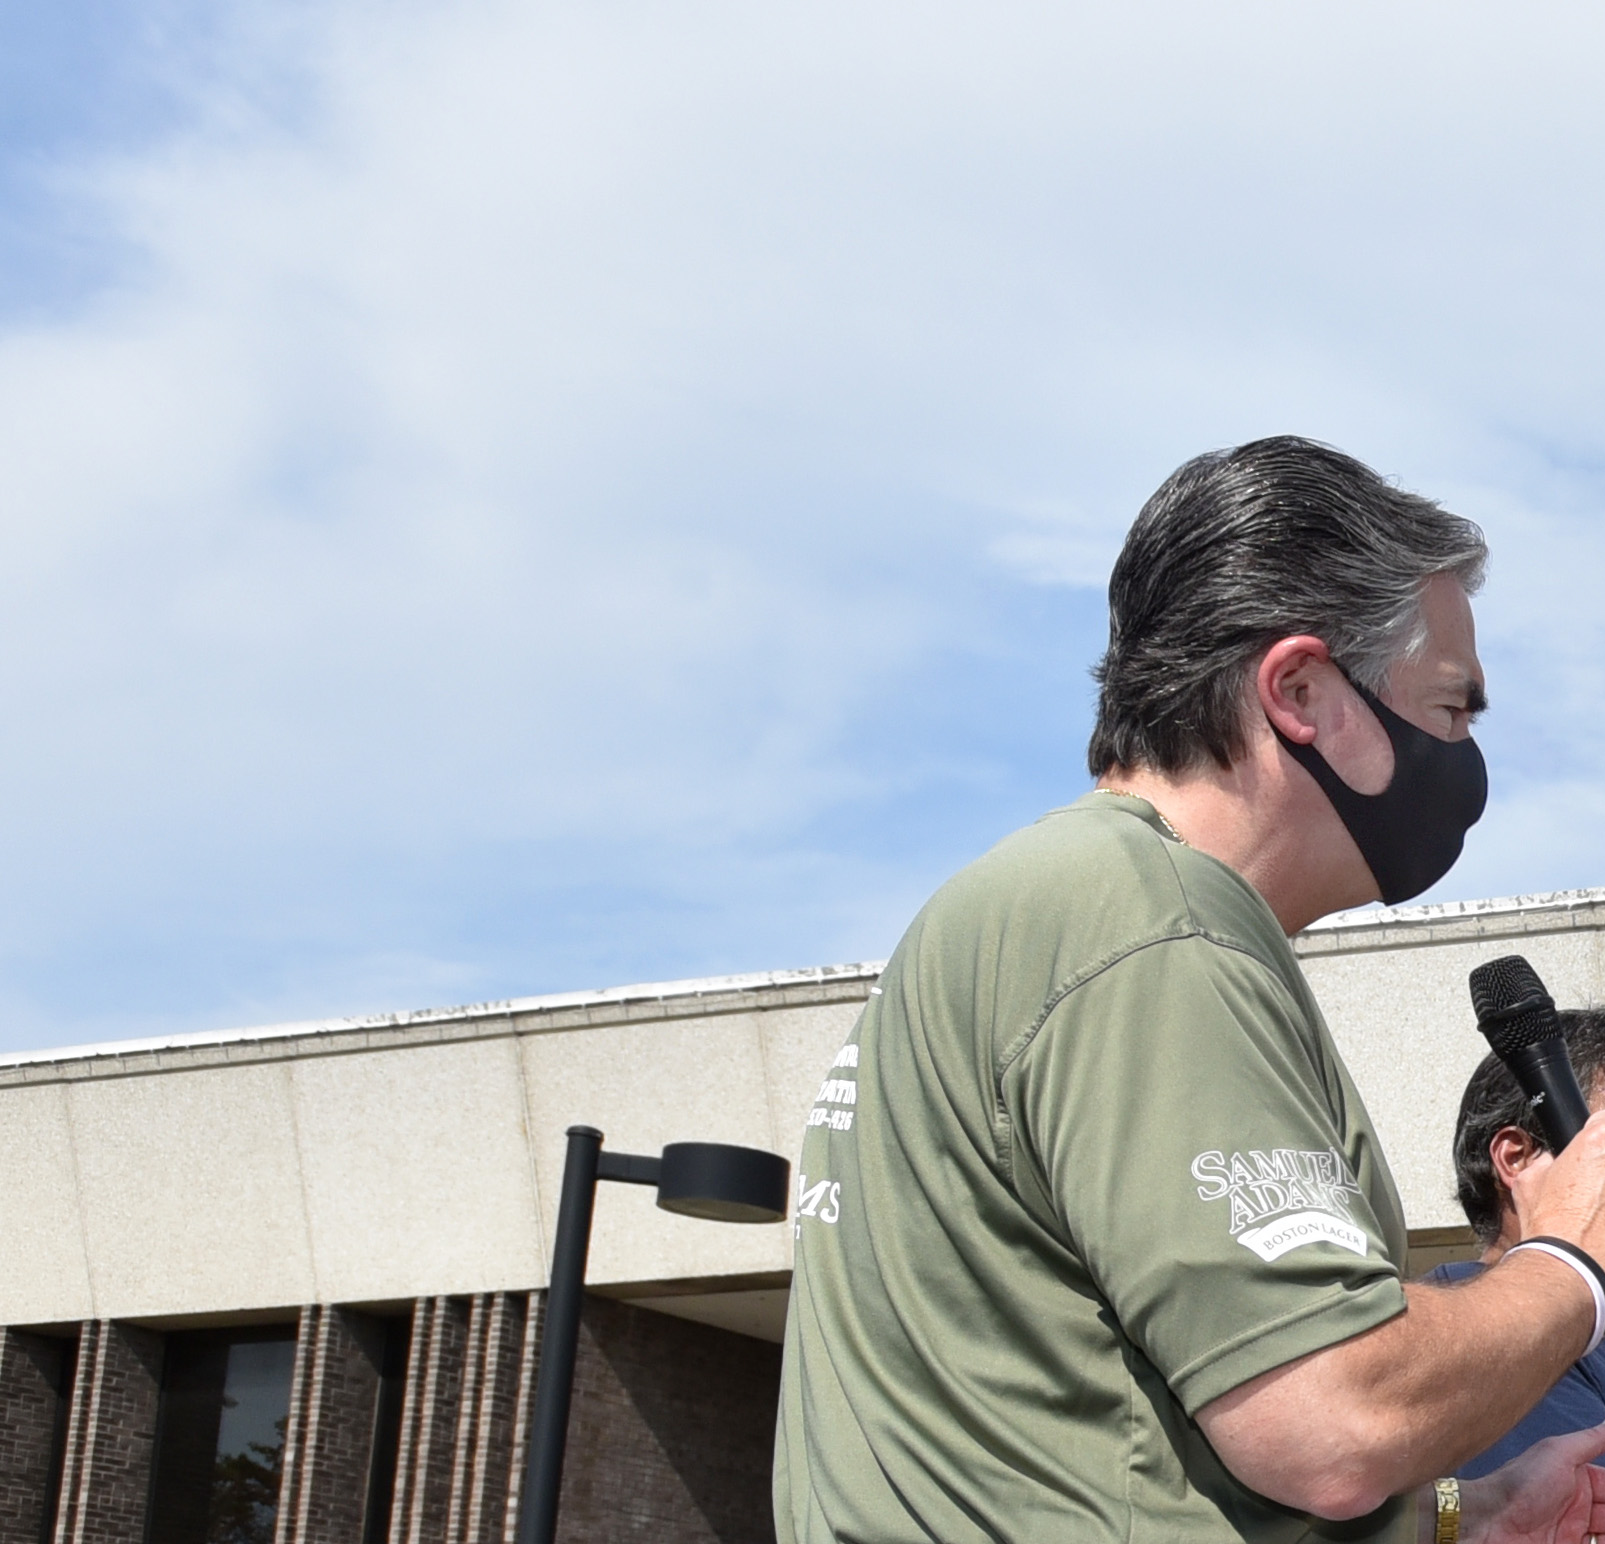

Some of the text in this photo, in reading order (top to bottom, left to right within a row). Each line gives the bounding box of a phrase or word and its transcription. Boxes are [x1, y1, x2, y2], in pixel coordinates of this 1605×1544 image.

[1191, 1147, 1363, 1201] SAMUEL
[1229, 1177, 1358, 1235] ADAMS
[1263, 1223, 1361, 1250] BOSTON LAGER
